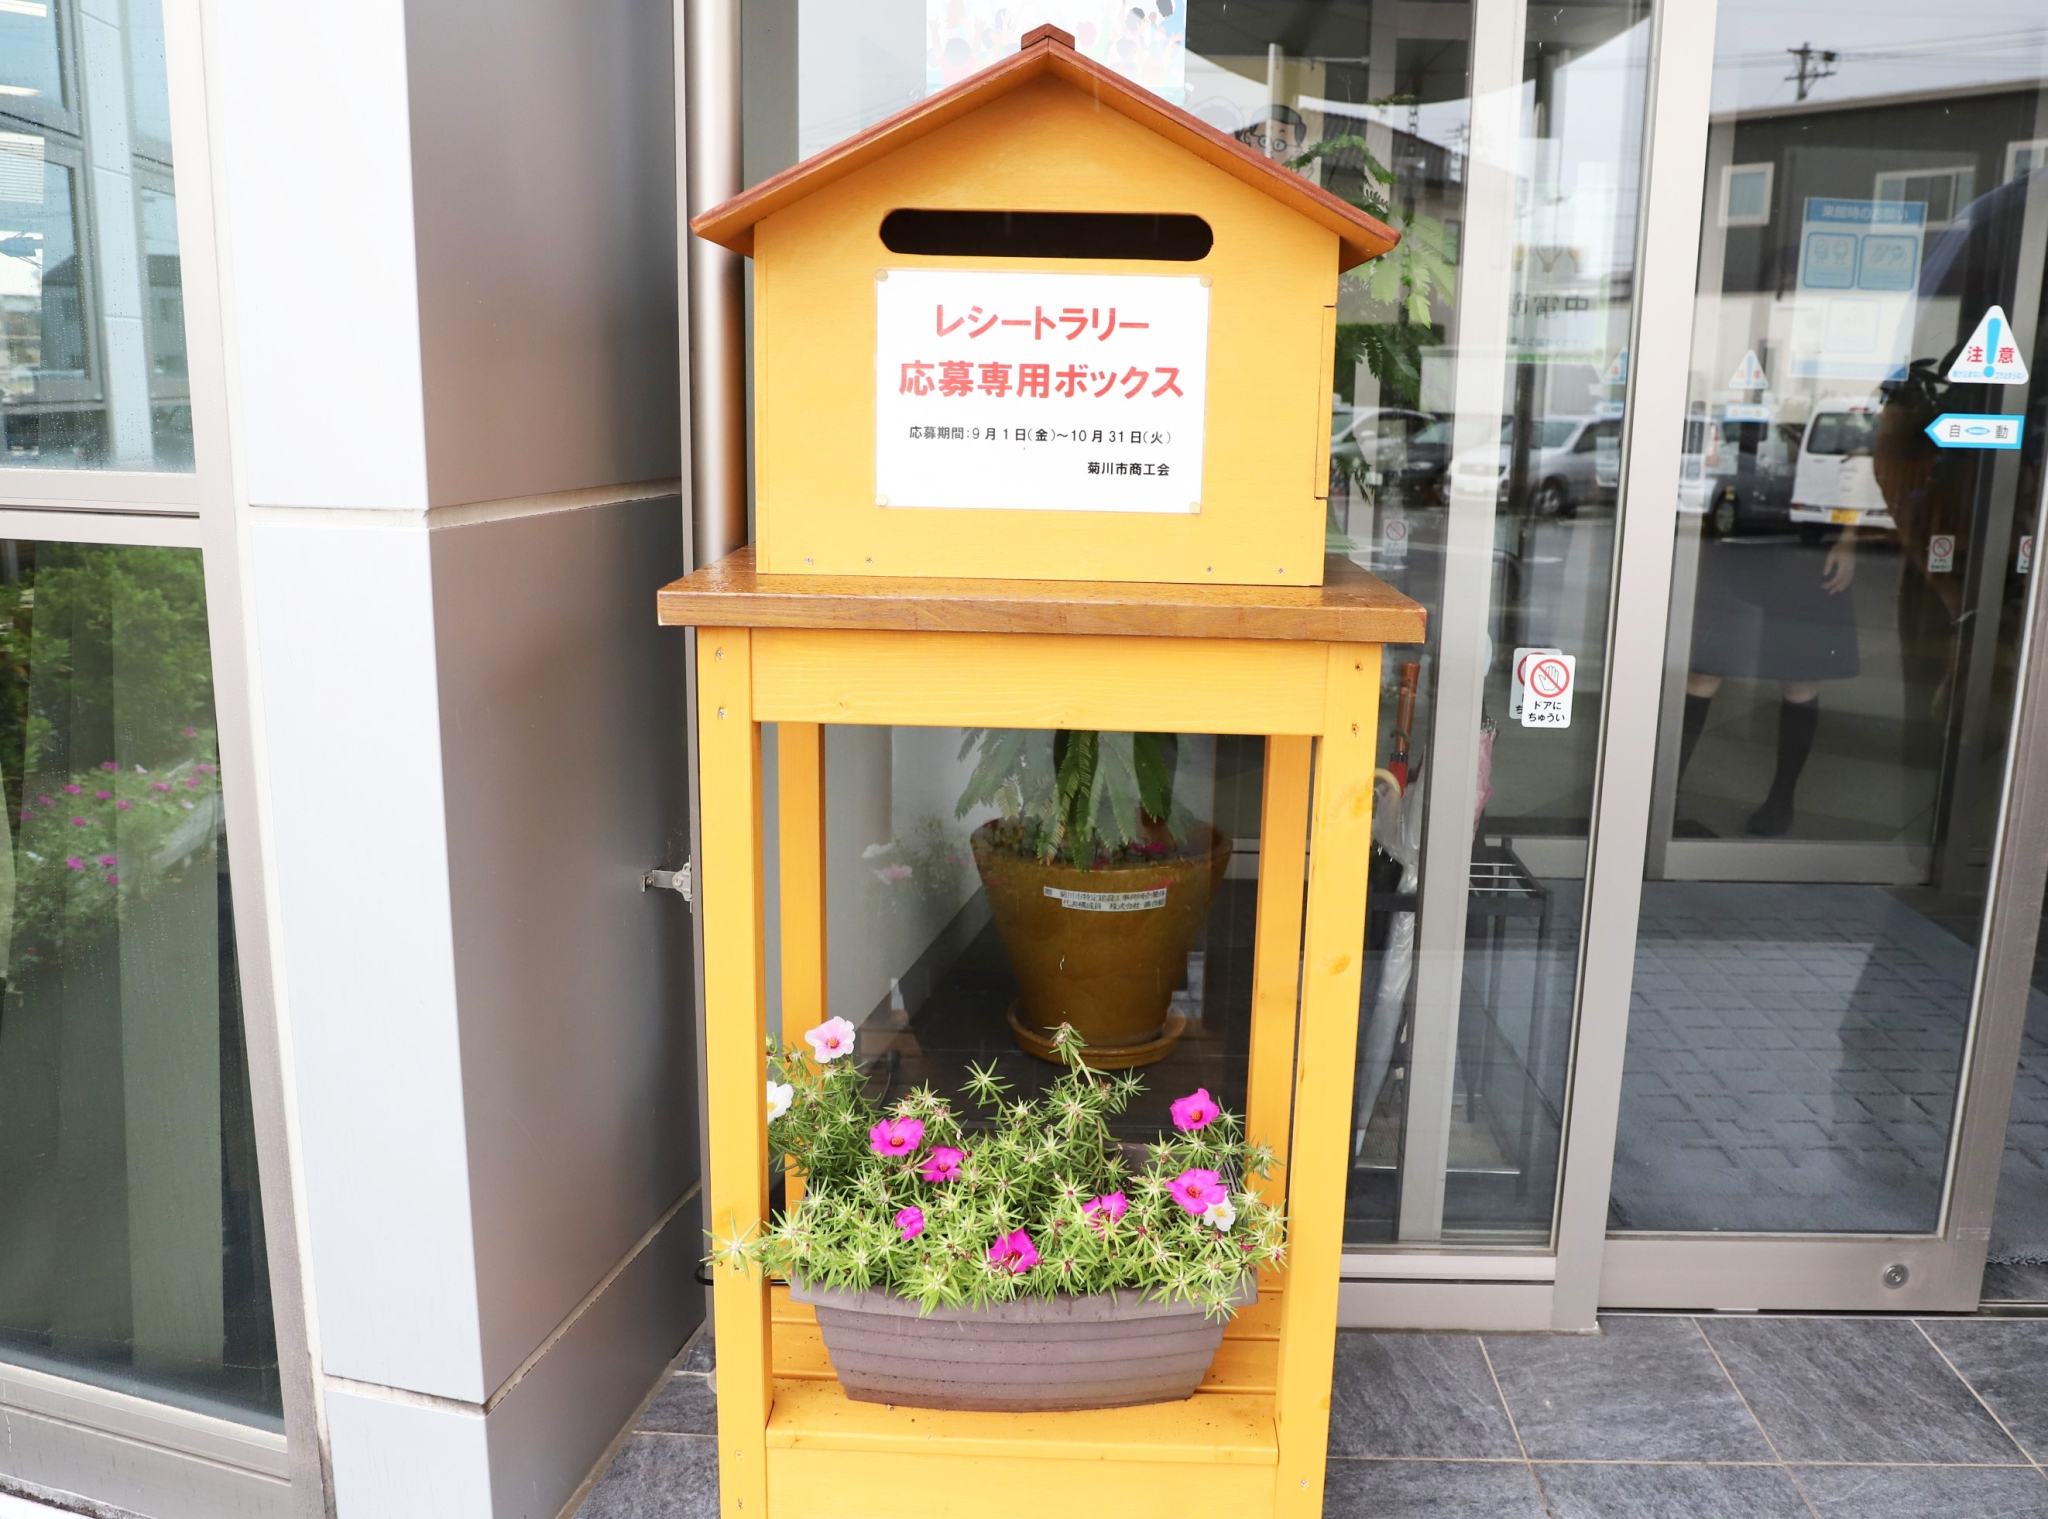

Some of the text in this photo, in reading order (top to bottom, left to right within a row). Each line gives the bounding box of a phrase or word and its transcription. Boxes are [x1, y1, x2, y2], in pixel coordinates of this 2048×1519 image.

[935, 305, 1150, 342] レシートラリー
[898, 360, 1184, 400] 応募専用ボックス
[1087, 462, 1170, 476] 菊川市商工会
[1535, 701, 1561, 710] ドアに
[1528, 713, 1565, 722] ちゅうい
